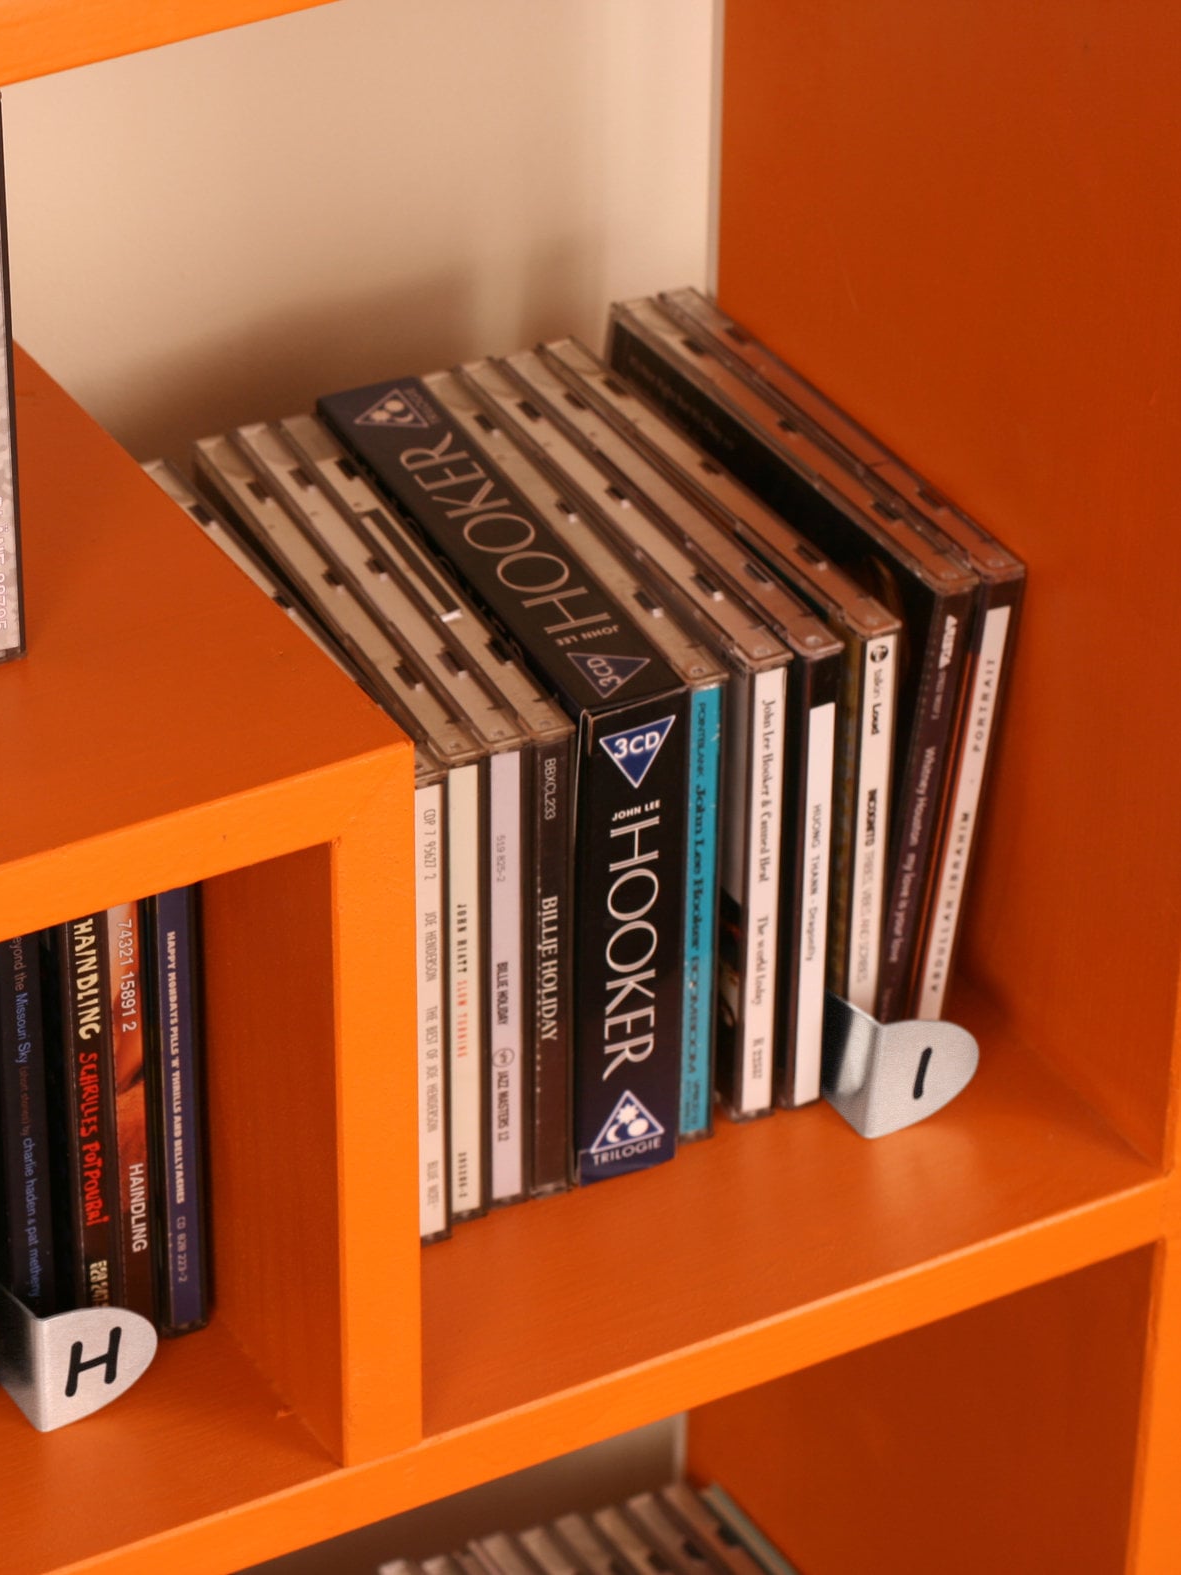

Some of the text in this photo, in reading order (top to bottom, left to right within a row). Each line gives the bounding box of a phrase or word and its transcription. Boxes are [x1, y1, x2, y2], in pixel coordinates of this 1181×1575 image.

[399, 432, 611, 634] HOOKER
[614, 731, 660, 759] 3CD
[611, 799, 661, 822] JOHN LEE
[691, 784, 706, 949] John Lee Hooker
[73, 917, 100, 1039] HAINDLING
[424, 911, 437, 982] JOE HENDERSON
[538, 896, 557, 1039] BILLIE HOLIDAY
[602, 816, 661, 1081] HOOKER
[496, 961, 508, 1024] BILLIE HOLIDAY
[593, 1137, 662, 1167] TRILOGIE
[128, 1162, 147, 1252] HAINDLING
[65, 1327, 122, 1397] H
